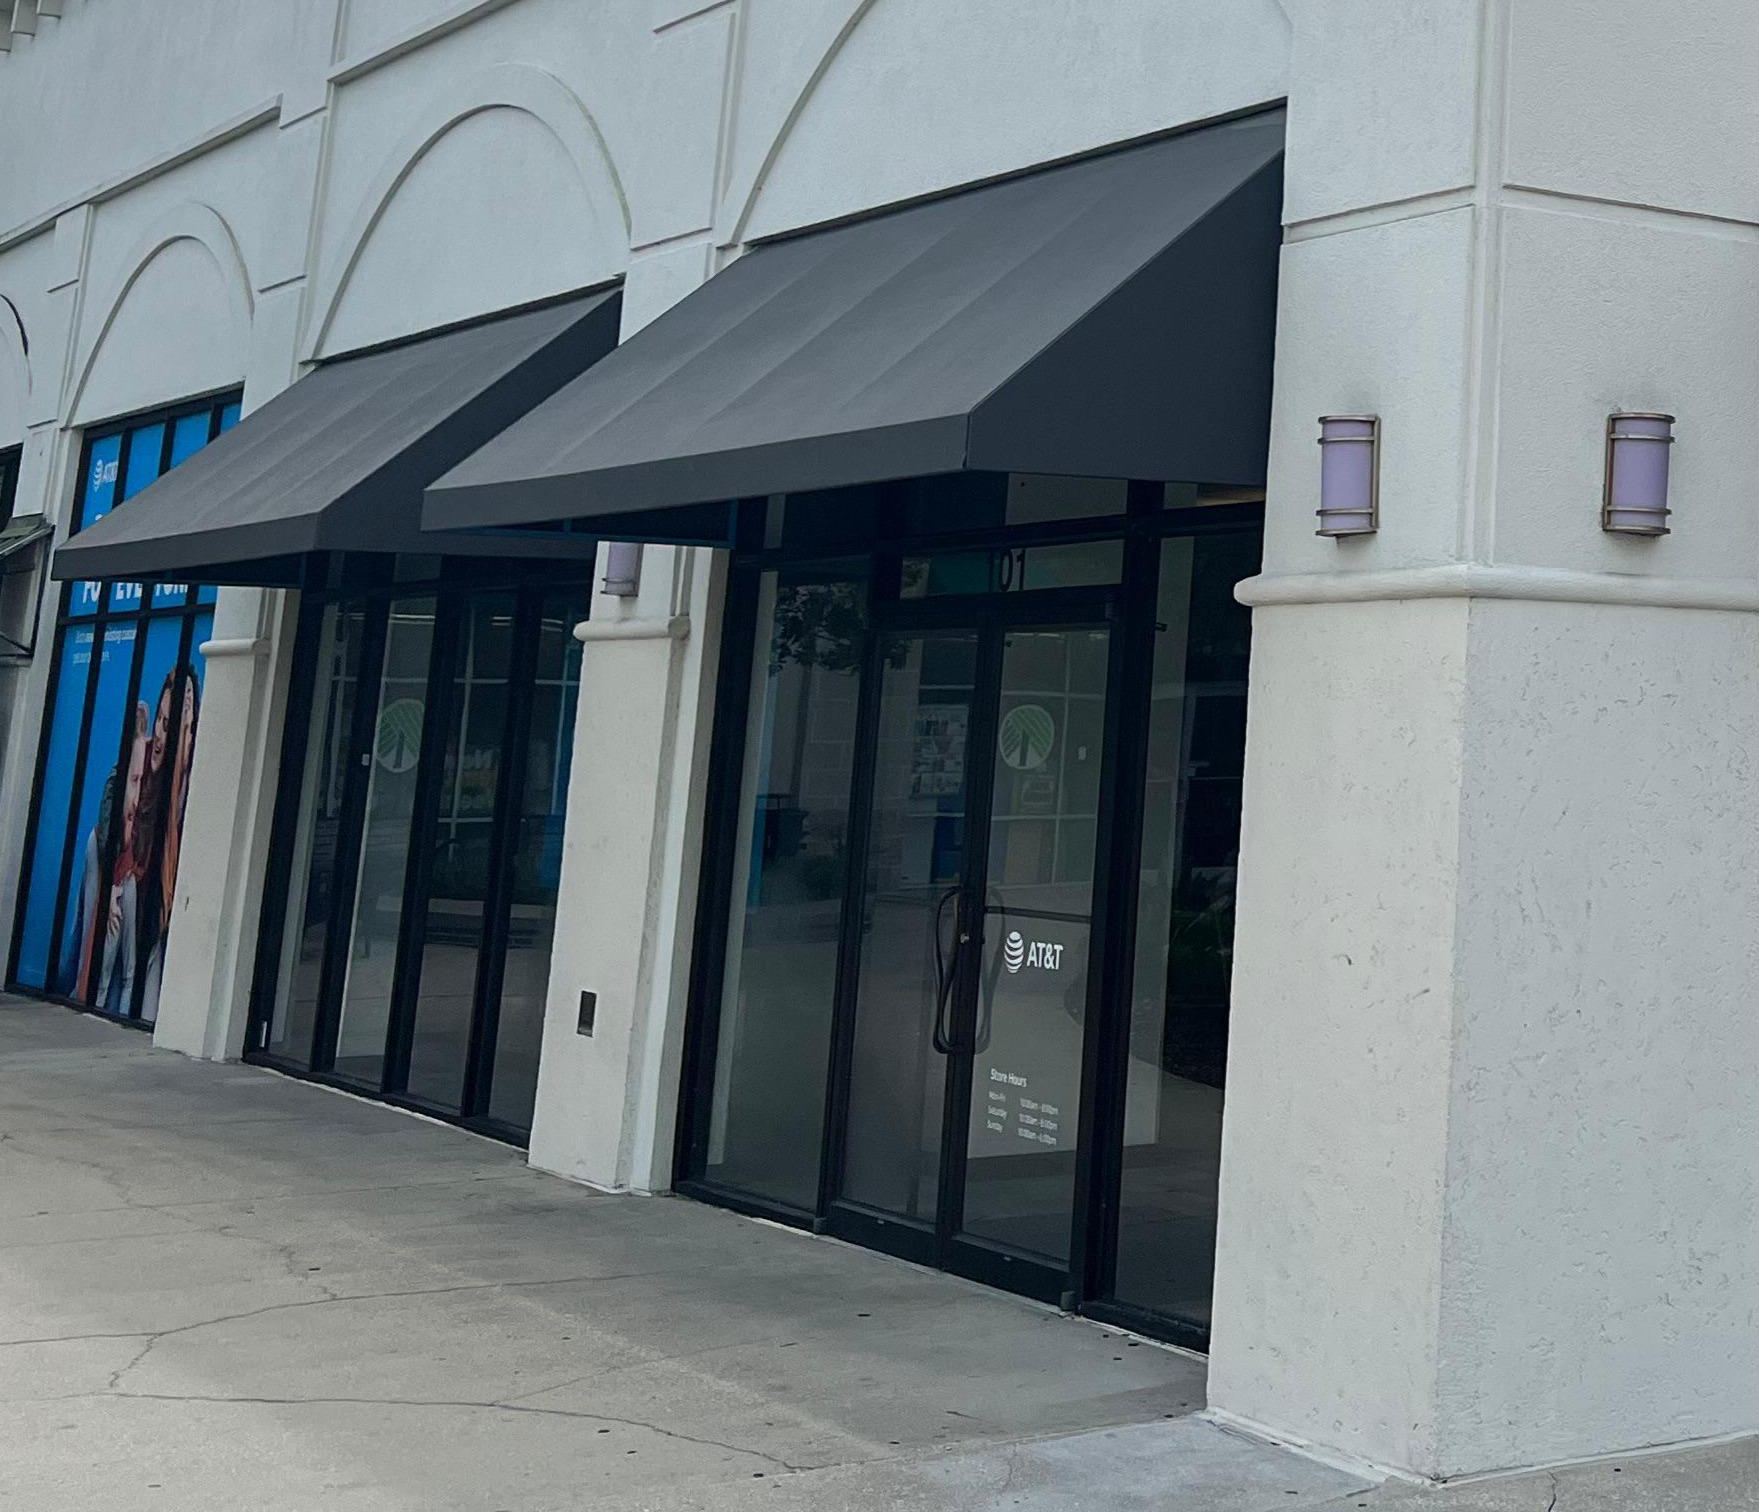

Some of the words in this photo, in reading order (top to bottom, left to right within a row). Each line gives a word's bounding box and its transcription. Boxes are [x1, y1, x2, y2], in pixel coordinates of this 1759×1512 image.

[1026, 941, 1064, 970] AT&T
[990, 1068, 1008, 1083] Store
[1008, 1073, 1027, 1087] Hours
